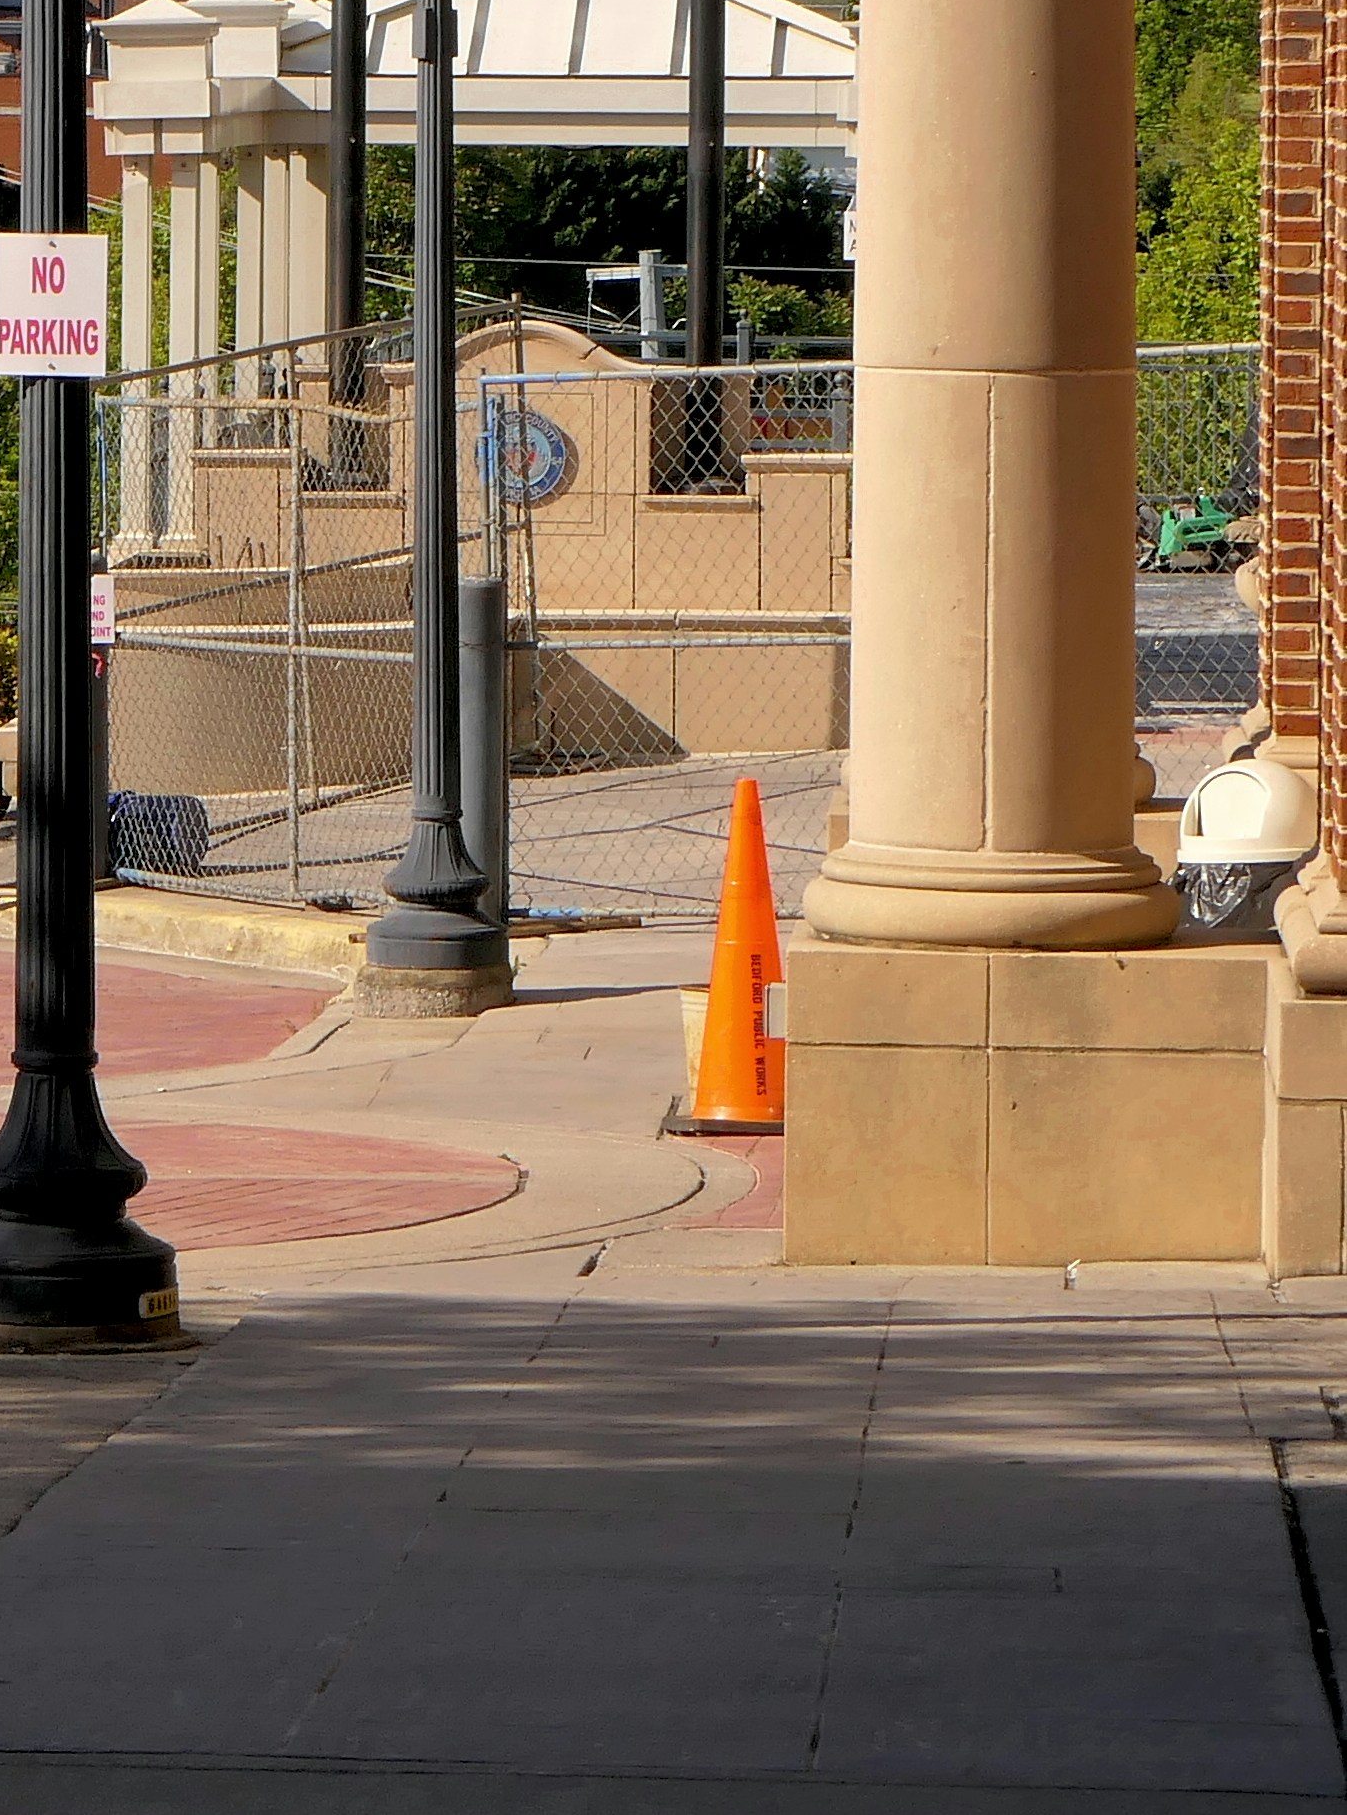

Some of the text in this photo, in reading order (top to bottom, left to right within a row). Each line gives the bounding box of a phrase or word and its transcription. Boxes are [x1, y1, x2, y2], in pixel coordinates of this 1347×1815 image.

[32, 256, 66, 294] NO
[91, 626, 112, 637] OINT
[750, 954, 767, 1097] BEDFORD PUBLIC WORKS
